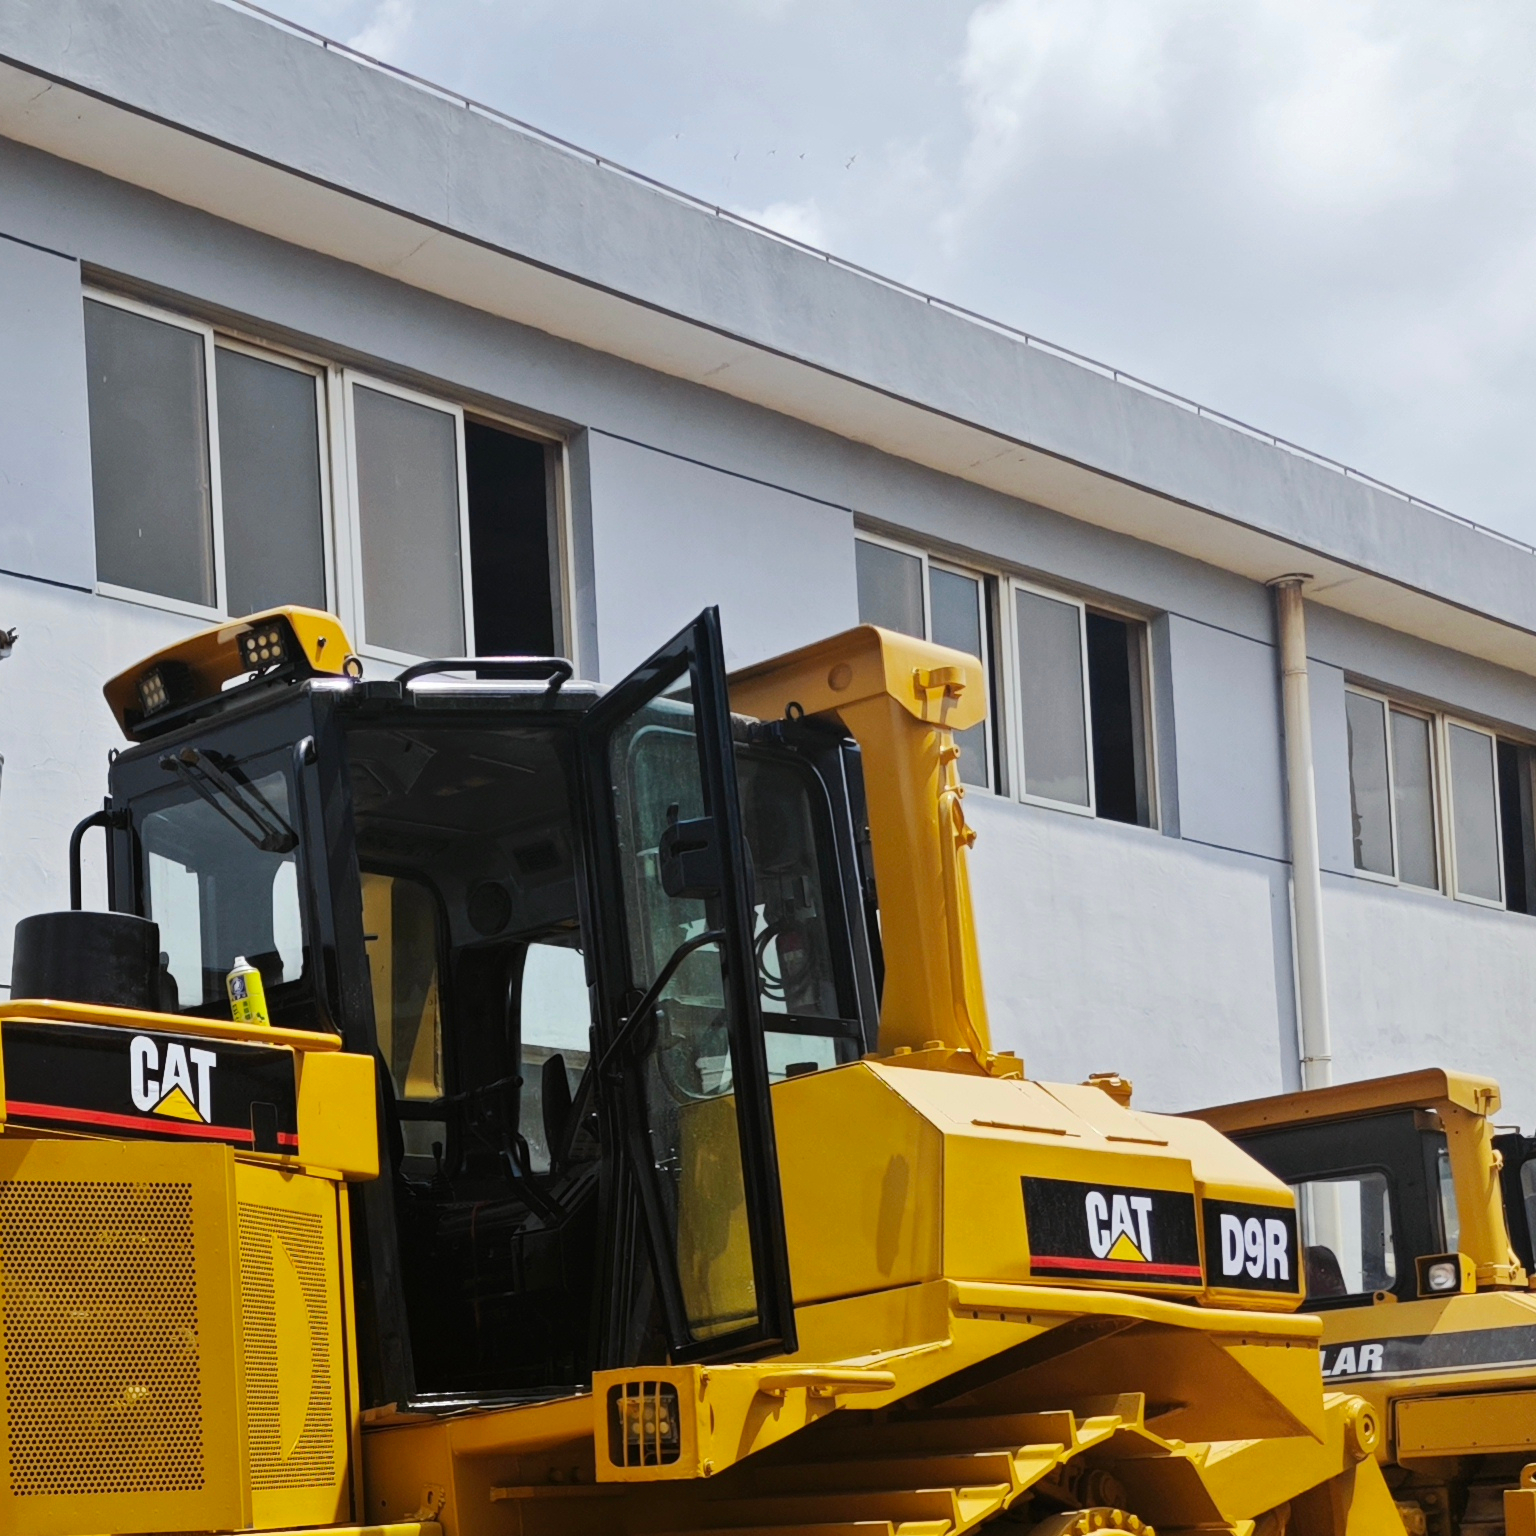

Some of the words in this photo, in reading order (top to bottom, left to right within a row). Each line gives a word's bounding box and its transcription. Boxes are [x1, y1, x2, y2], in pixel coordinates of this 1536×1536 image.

[130, 1035, 216, 1124] CAT
[1085, 1191, 1153, 1262] CAT
[1220, 1213, 1290, 1281] D9R
